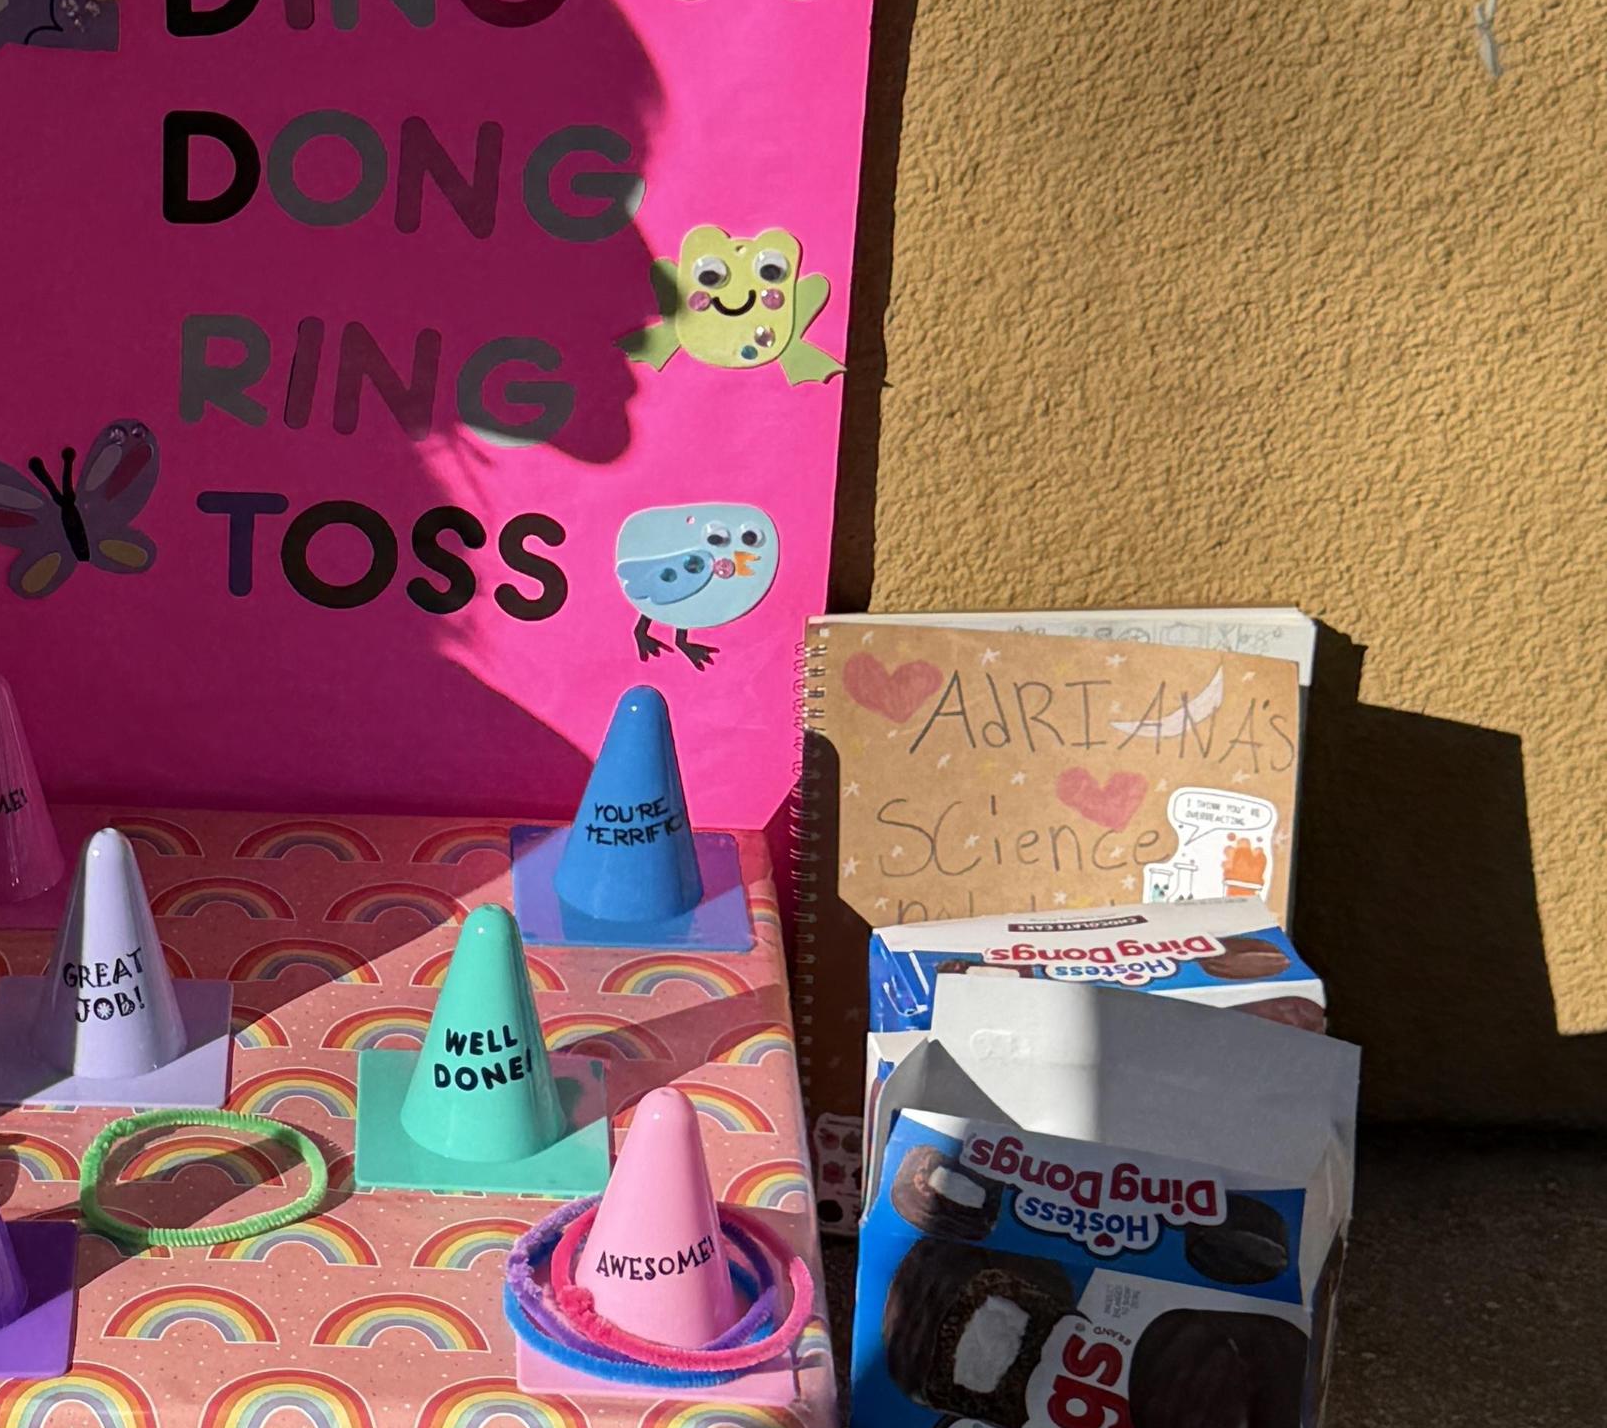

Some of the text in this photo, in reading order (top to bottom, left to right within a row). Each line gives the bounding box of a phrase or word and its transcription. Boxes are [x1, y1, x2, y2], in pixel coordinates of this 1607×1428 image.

[162, 109, 645, 243] DONG
[179, 313, 575, 446] RING
[196, 492, 568, 621] TOSS
[594, 795, 669, 824] YOU'RE
[62, 946, 143, 988] GREAT
[989, 935, 1216, 965] Ding Dongs
[1054, 959, 1170, 978] Hostess
[75, 985, 145, 1023] JOB!
[445, 1024, 518, 1057] WELL
[969, 1136, 1218, 1217] Ding Dongs
[1023, 1196, 1149, 1242] Hostess
[595, 1235, 716, 1281] AWESOME!
